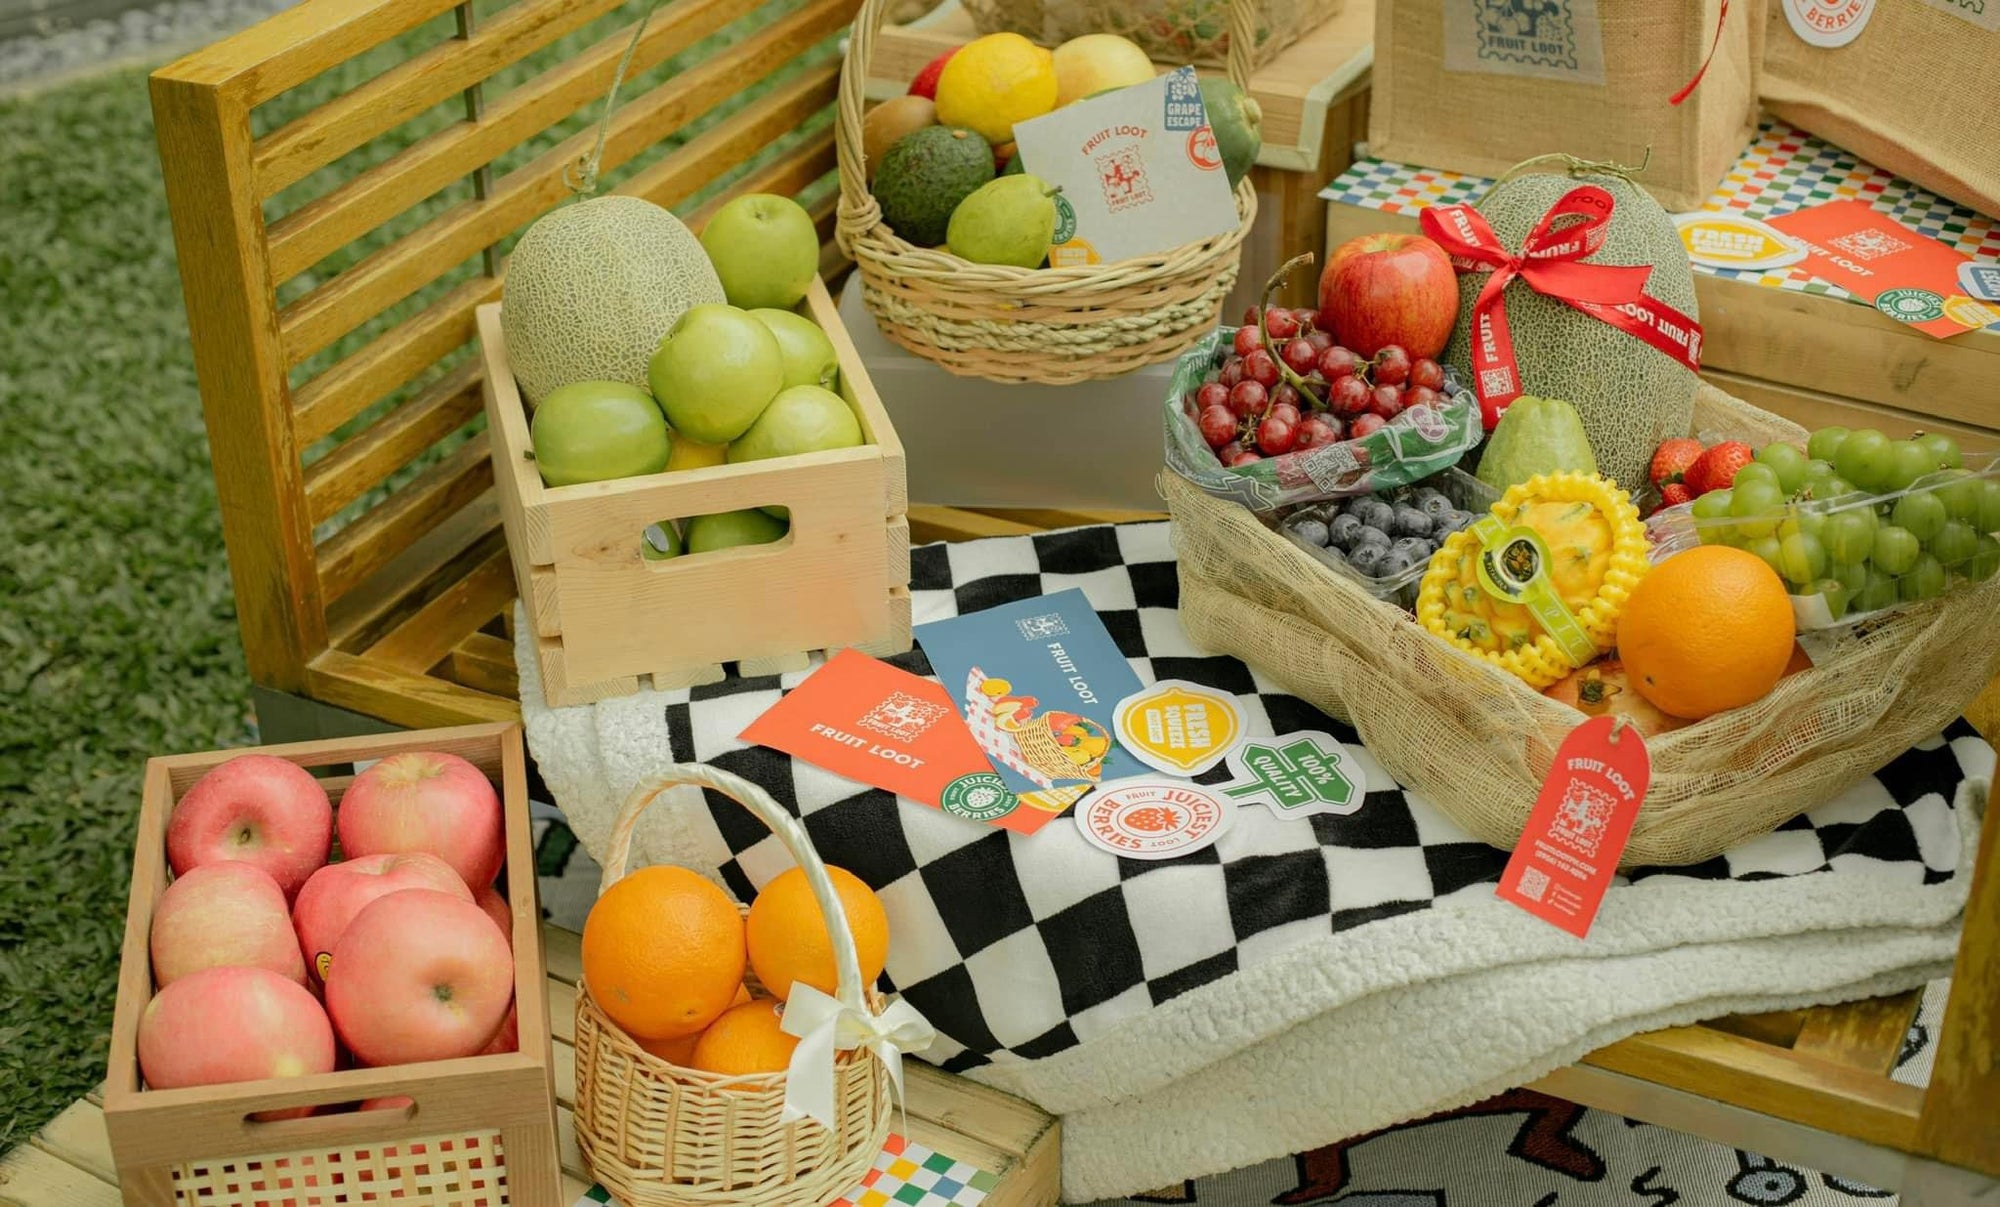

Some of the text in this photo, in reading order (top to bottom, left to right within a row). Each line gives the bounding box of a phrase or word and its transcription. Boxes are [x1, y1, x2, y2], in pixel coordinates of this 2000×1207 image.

[1806, 2, 1861, 29] BERRIE
[1487, 36, 1563, 55] FRUIT LOOT
[1166, 116, 1202, 128] ESCAPE
[1167, 102, 1202, 116] GRAPE
[1081, 125, 1149, 156] FRUIT LOOT
[1830, 256, 1874, 276] LOOT
[1480, 313, 1499, 363] FRUIT
[1656, 319, 1690, 347] FRUIT
[1047, 641, 1098, 705] FRUIT LOOT
[810, 722, 925, 771] FRUIT LOOT
[1254, 755, 1304, 800] QUALITY
[1297, 753, 1337, 786] 100%
[1567, 758, 1636, 801] FRUIT LOOT
[1125, 790, 1157, 801] FRUIT
[947, 802, 1006, 821] BERRIES
[1093, 799, 1142, 850] BERRIES
[1163, 789, 1214, 841] JUICIEST
[1151, 837, 1181, 849] LOOT
